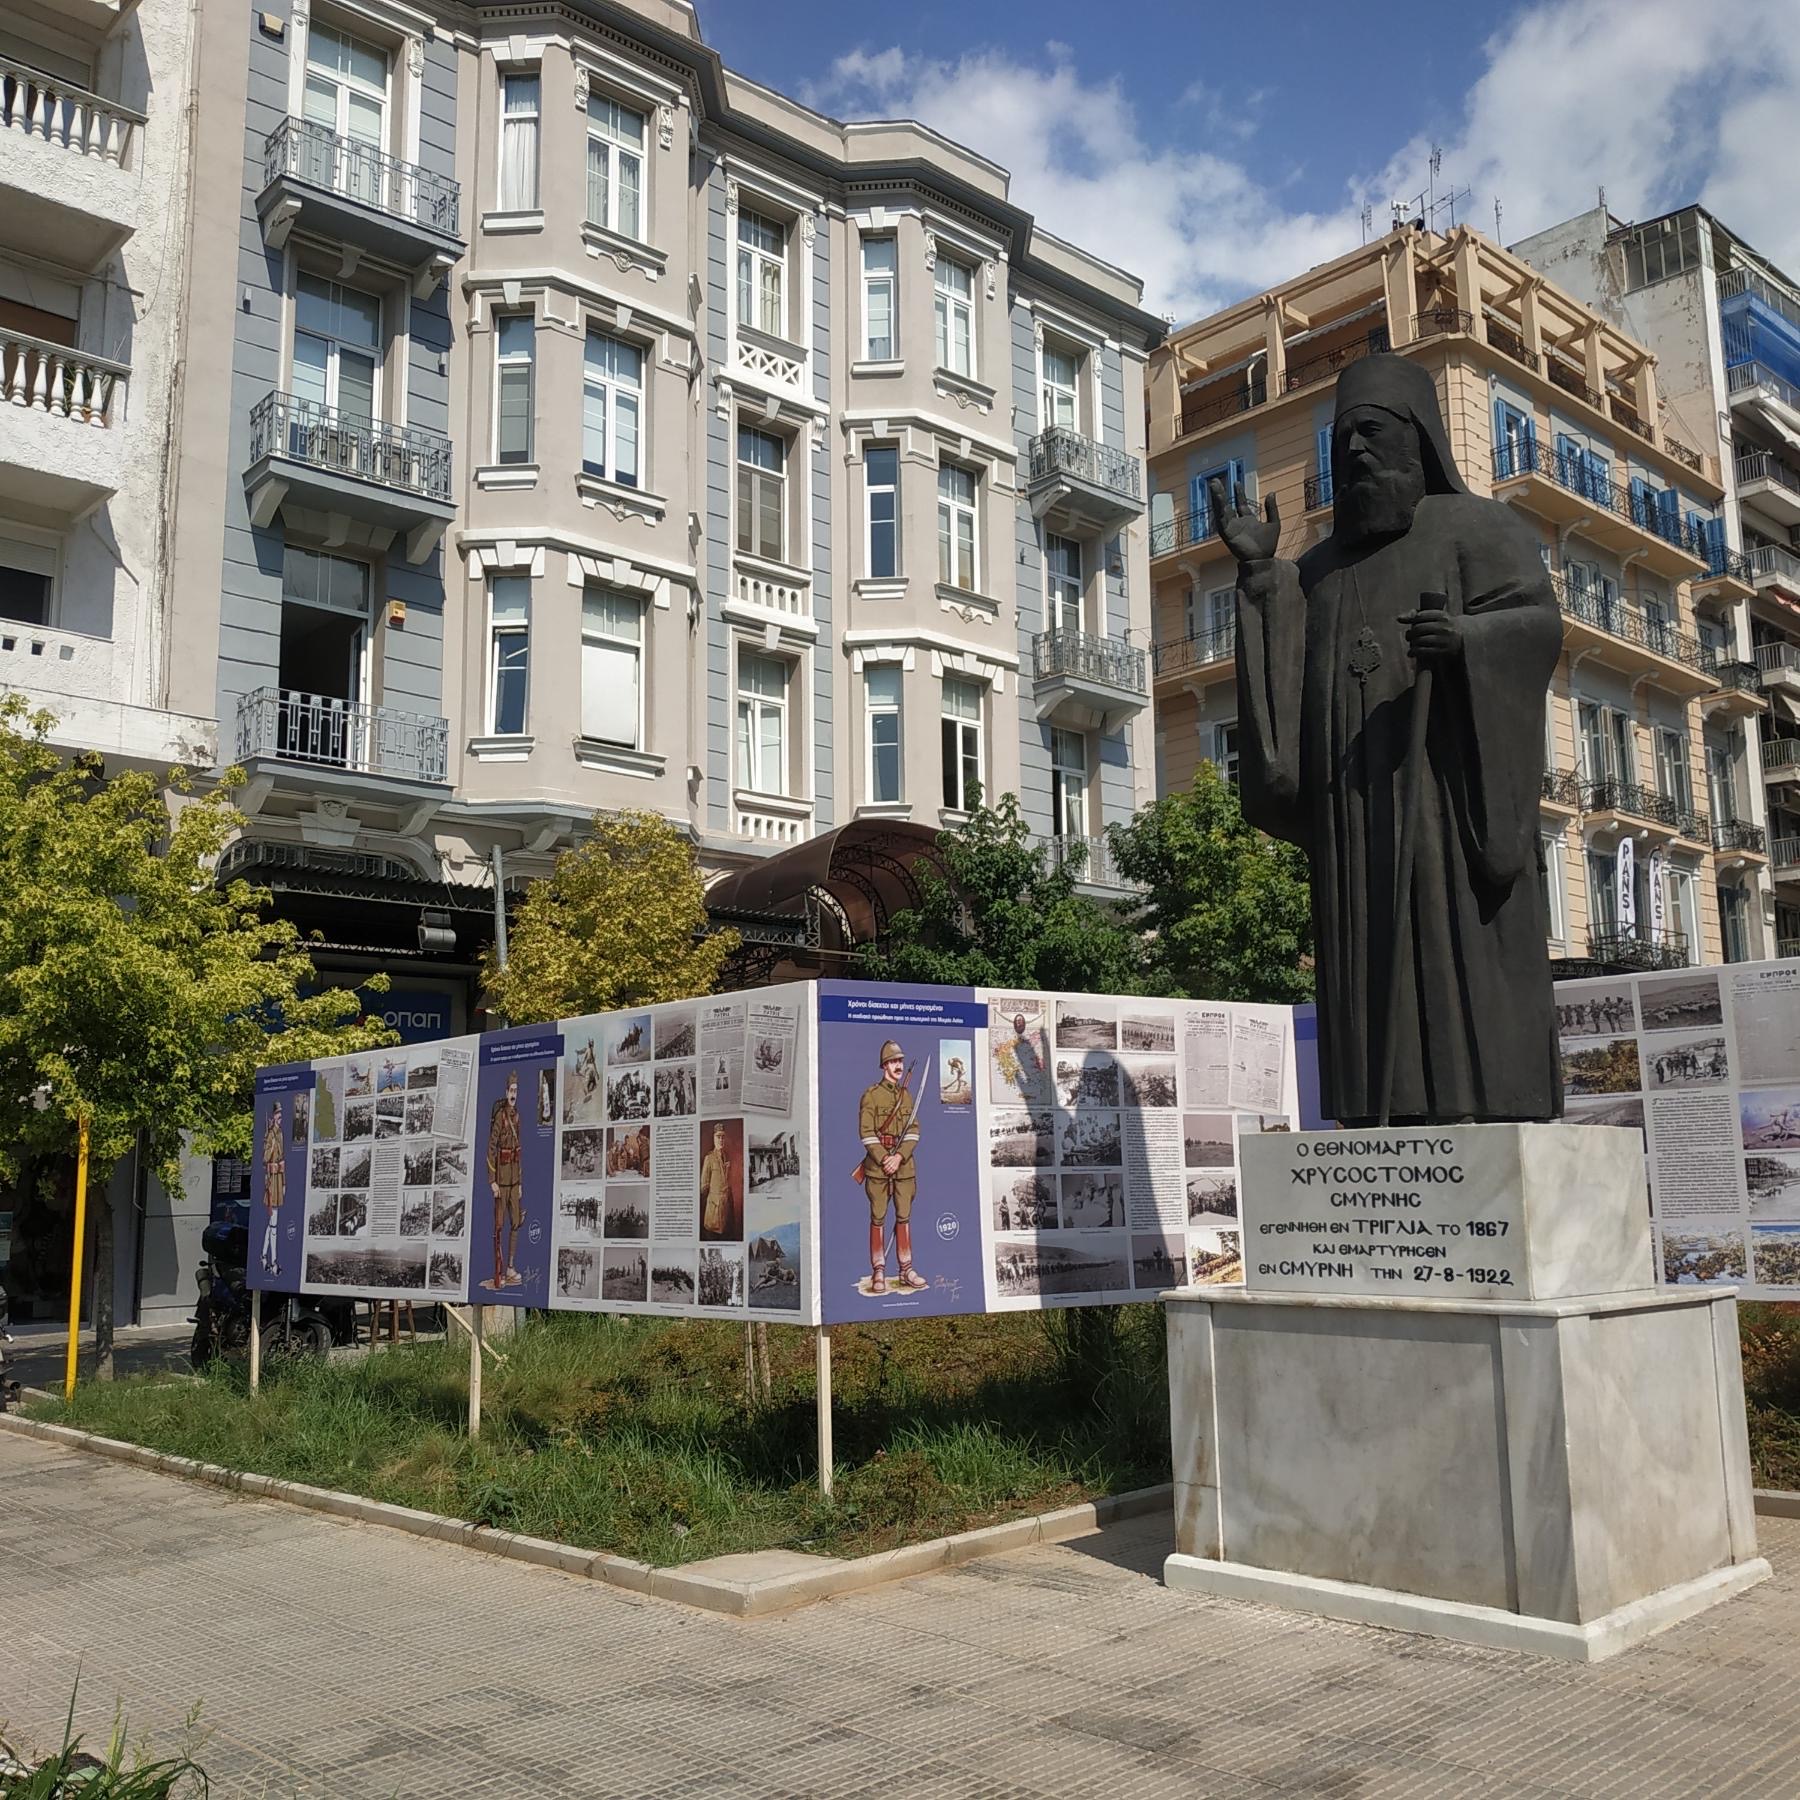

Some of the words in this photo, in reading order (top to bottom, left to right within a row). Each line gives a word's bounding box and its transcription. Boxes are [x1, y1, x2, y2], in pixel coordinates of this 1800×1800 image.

[1296, 1142, 1309, 1157] Ο
[939, 1221, 957, 1232] 1920
[1352, 1219, 1432, 1236] ΤΡΙΓΛΙΑ
[1437, 1223, 1461, 1236] ΤΟ
[1465, 1220, 1509, 1237] 1867
[1312, 1243, 1336, 1255] ΚΑΙ
[1370, 1266, 1402, 1280] ΤΗΝ
[1413, 1265, 1514, 1286] 27-8-1922
